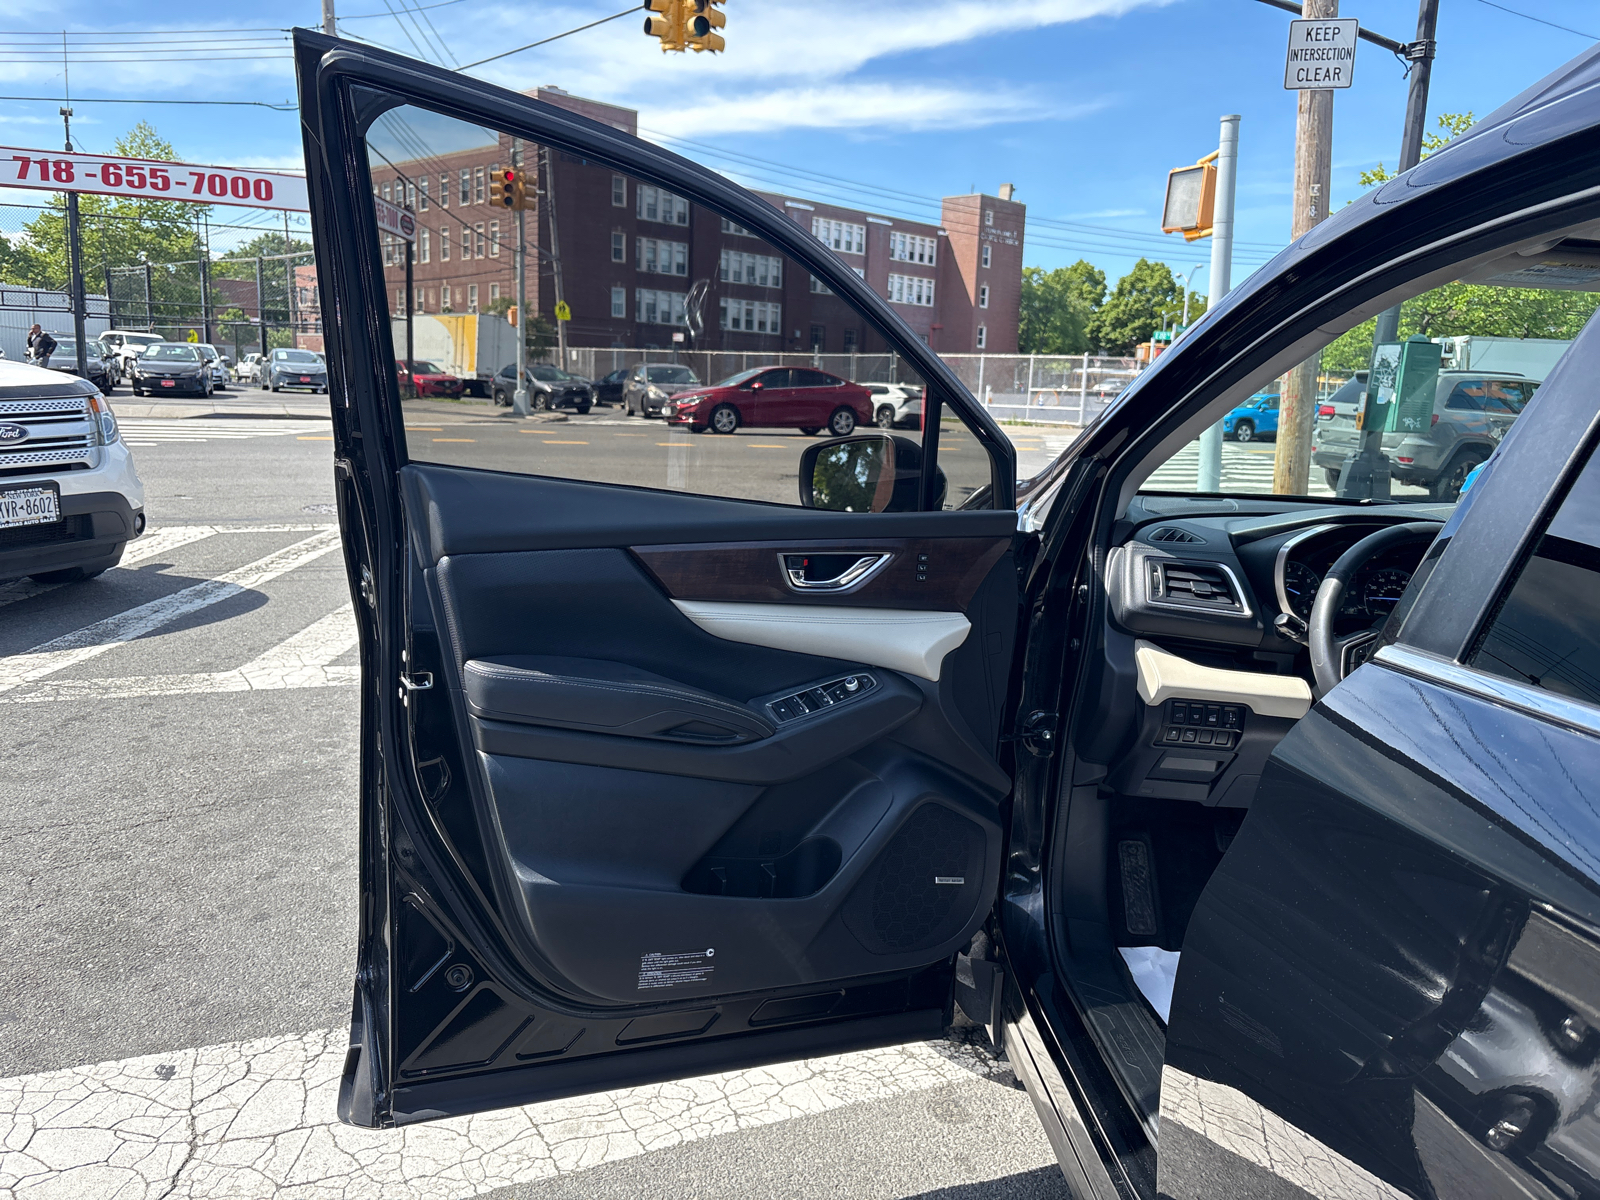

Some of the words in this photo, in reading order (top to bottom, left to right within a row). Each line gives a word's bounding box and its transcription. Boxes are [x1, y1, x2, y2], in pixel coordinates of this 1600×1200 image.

[1305, 27, 1341, 42] KEEP
[1290, 47, 1353, 62] INTERSECTION
[1296, 67, 1342, 82] CLEAR
